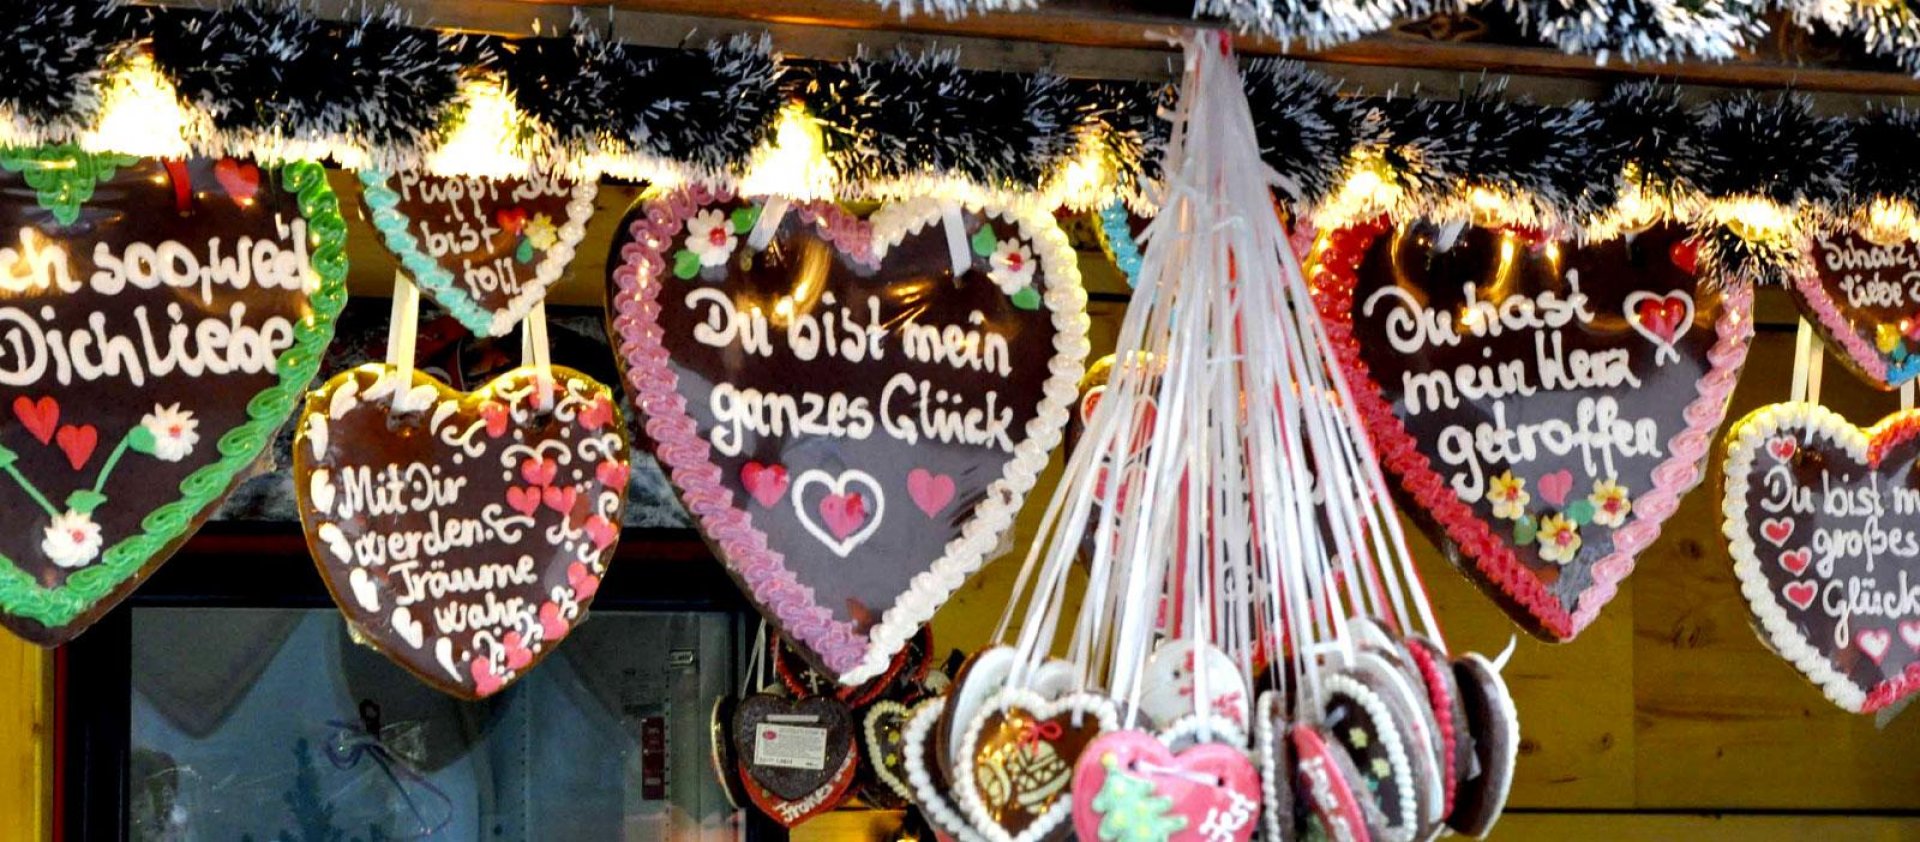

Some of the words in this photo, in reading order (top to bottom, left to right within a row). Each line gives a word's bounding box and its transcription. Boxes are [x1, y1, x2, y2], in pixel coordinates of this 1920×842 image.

[420, 214, 501, 258] bist
[0, 304, 145, 387] Dich
[134, 301, 294, 376] liebe
[684, 287, 773, 357] Du
[775, 290, 888, 363] bist
[903, 309, 1012, 377] mein
[1363, 285, 1461, 354] Du
[1461, 268, 1595, 338] hast
[1402, 346, 1536, 416] mein
[1534, 330, 1641, 390] Herz
[710, 382, 874, 457] ganzes
[880, 372, 1014, 453] Glück
[1437, 396, 1662, 502] getroffen
[338, 462, 408, 519] Mit
[405, 462, 467, 511] Dir
[1760, 465, 1815, 512] Du
[1822, 468, 1884, 517] bist
[354, 510, 484, 566] werden
[1812, 515, 1920, 578] großes
[388, 554, 538, 605] Träume
[434, 591, 523, 634] wahr
[1822, 570, 1920, 649] Glück
